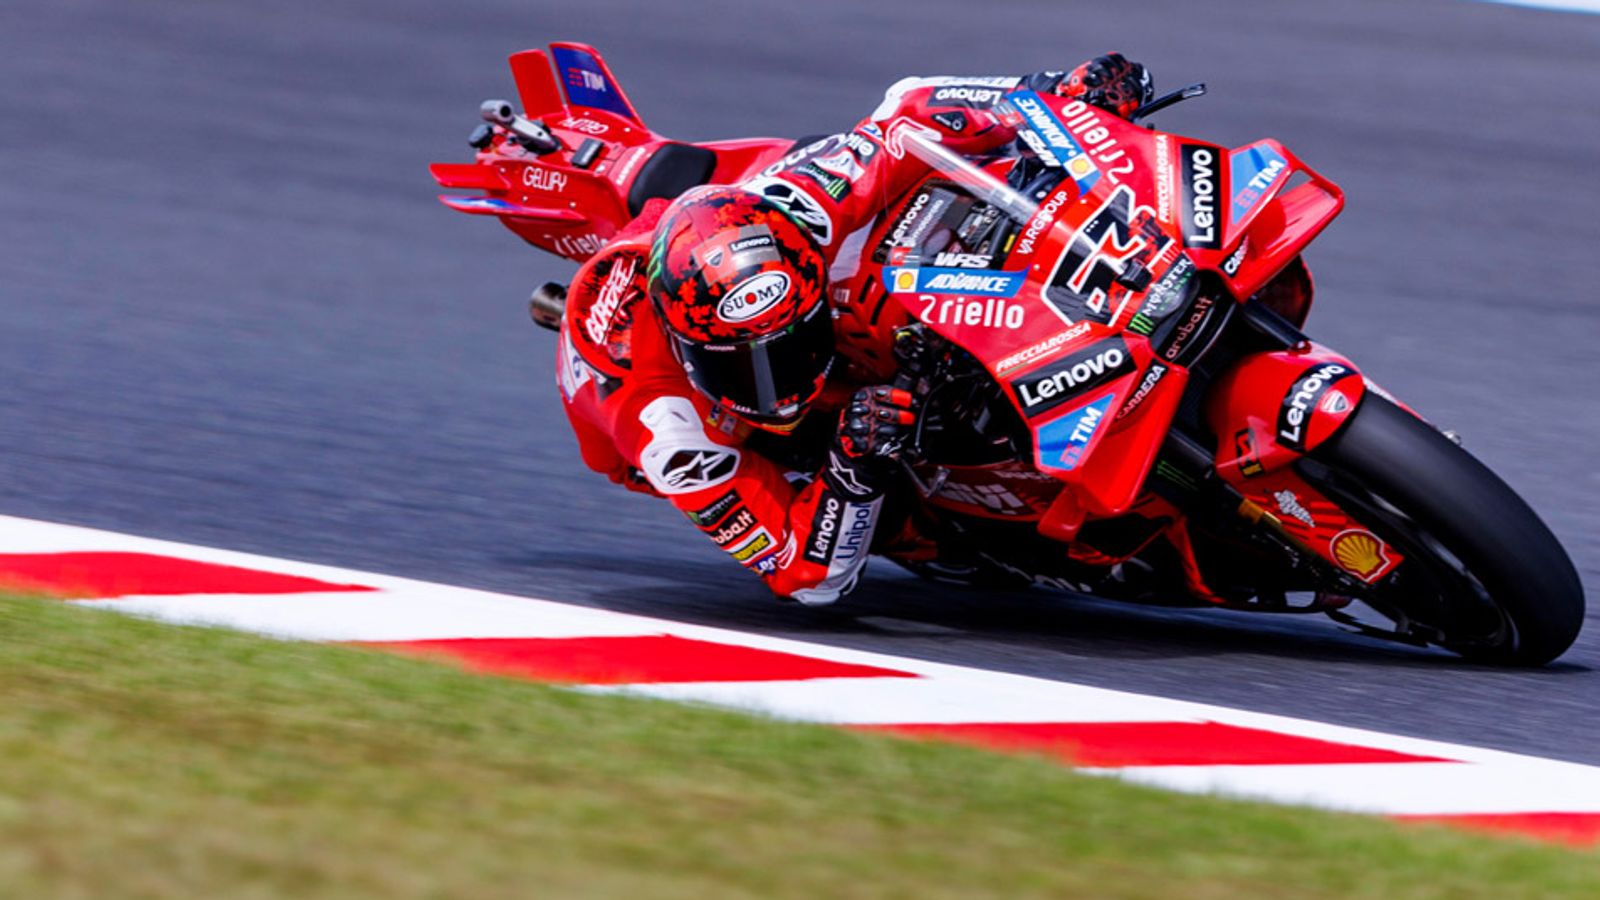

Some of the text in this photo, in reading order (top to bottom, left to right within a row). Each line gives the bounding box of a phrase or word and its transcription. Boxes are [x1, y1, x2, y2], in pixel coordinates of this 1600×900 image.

[580, 70, 606, 92] TIM
[935, 87, 1001, 105] Lenovo
[1248, 159, 1286, 189] TIM
[1189, 149, 1214, 243] Lenovo
[885, 193, 930, 247] Lenovo
[731, 236, 770, 251] Lenovo
[934, 252, 993, 268] WRS
[724, 280, 783, 313] SUOMY
[925, 272, 1012, 293] ADVANCE
[996, 321, 1092, 373] FRECCIAROSSA
[1018, 348, 1124, 408] Lenovo
[1280, 363, 1346, 443] Lenovo
[1070, 405, 1104, 443] TIM
[809, 498, 840, 560] Lenovo
[836, 502, 871, 560] Unipol
